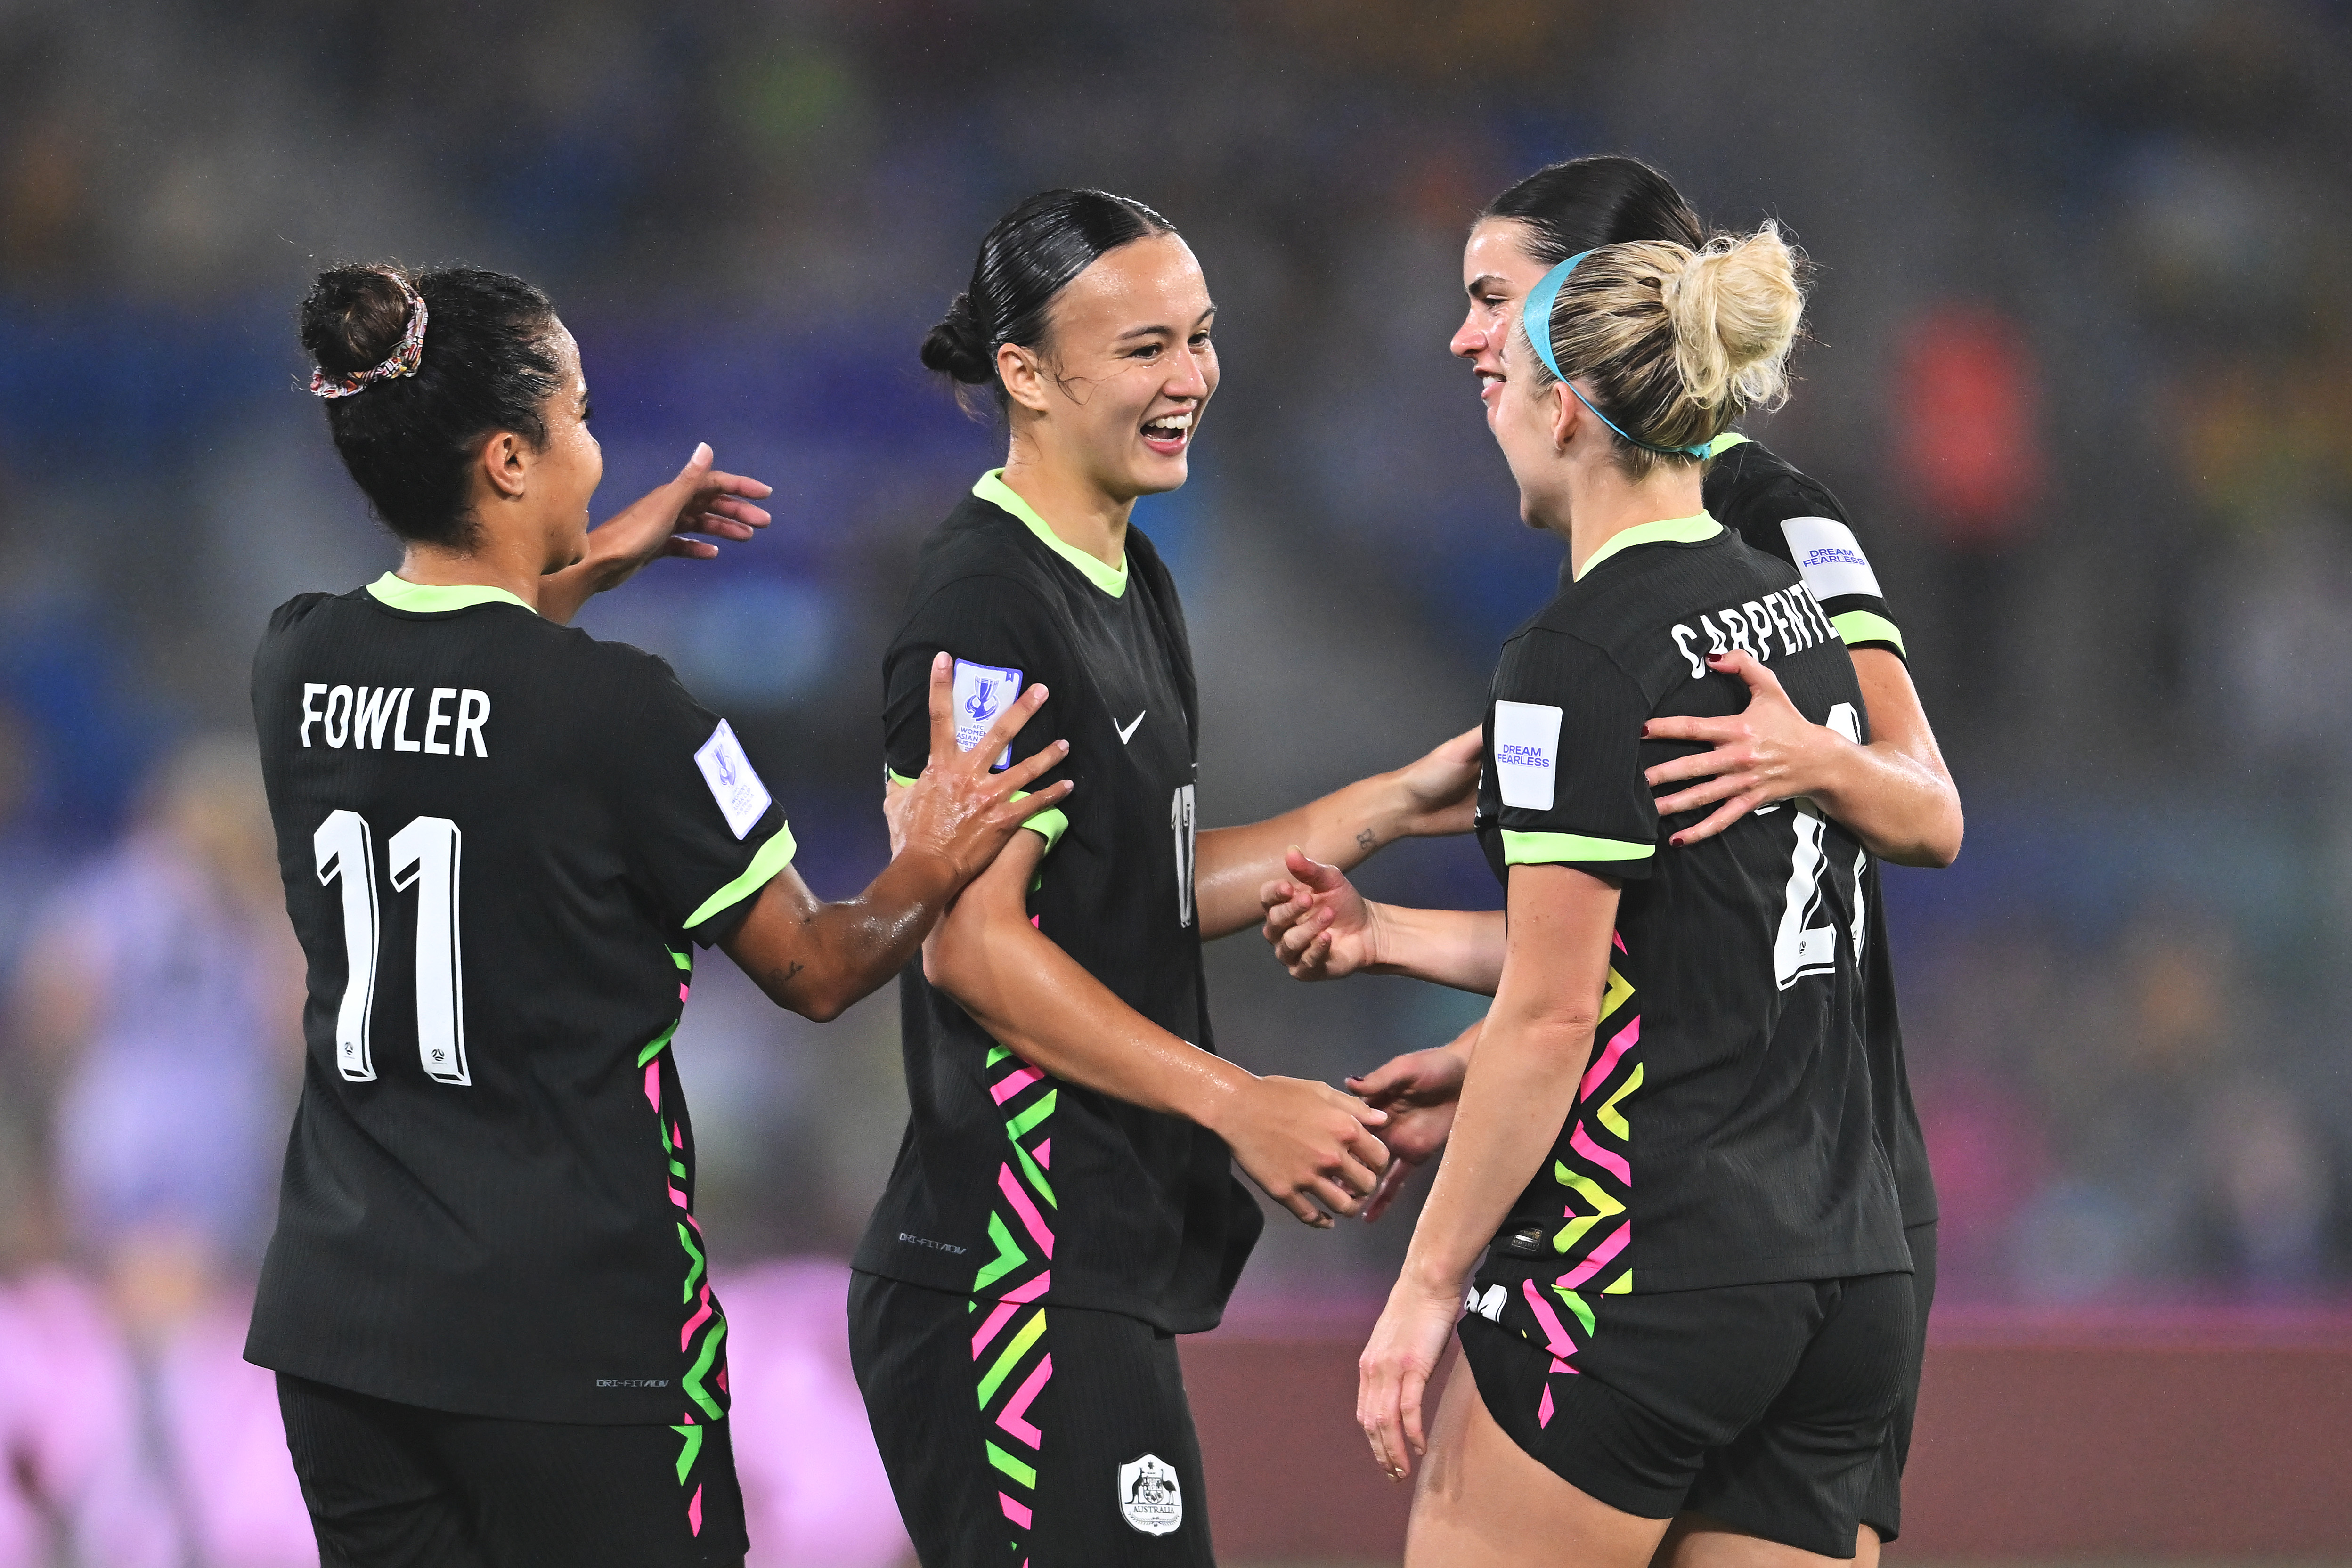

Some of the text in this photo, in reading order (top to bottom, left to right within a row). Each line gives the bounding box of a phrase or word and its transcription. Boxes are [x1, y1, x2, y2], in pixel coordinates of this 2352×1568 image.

[1809, 548, 1854, 558] DREAM
[1803, 556, 1865, 568] FEARLESS
[301, 683, 491, 758] FOWLER
[956, 732, 979, 742] ASIAN
[1503, 744, 1542, 757] DREAM
[1497, 754, 1550, 768] FEARLESS
[313, 809, 472, 1087] 11
[1133, 1506, 1175, 1514] AUSTRALIA
